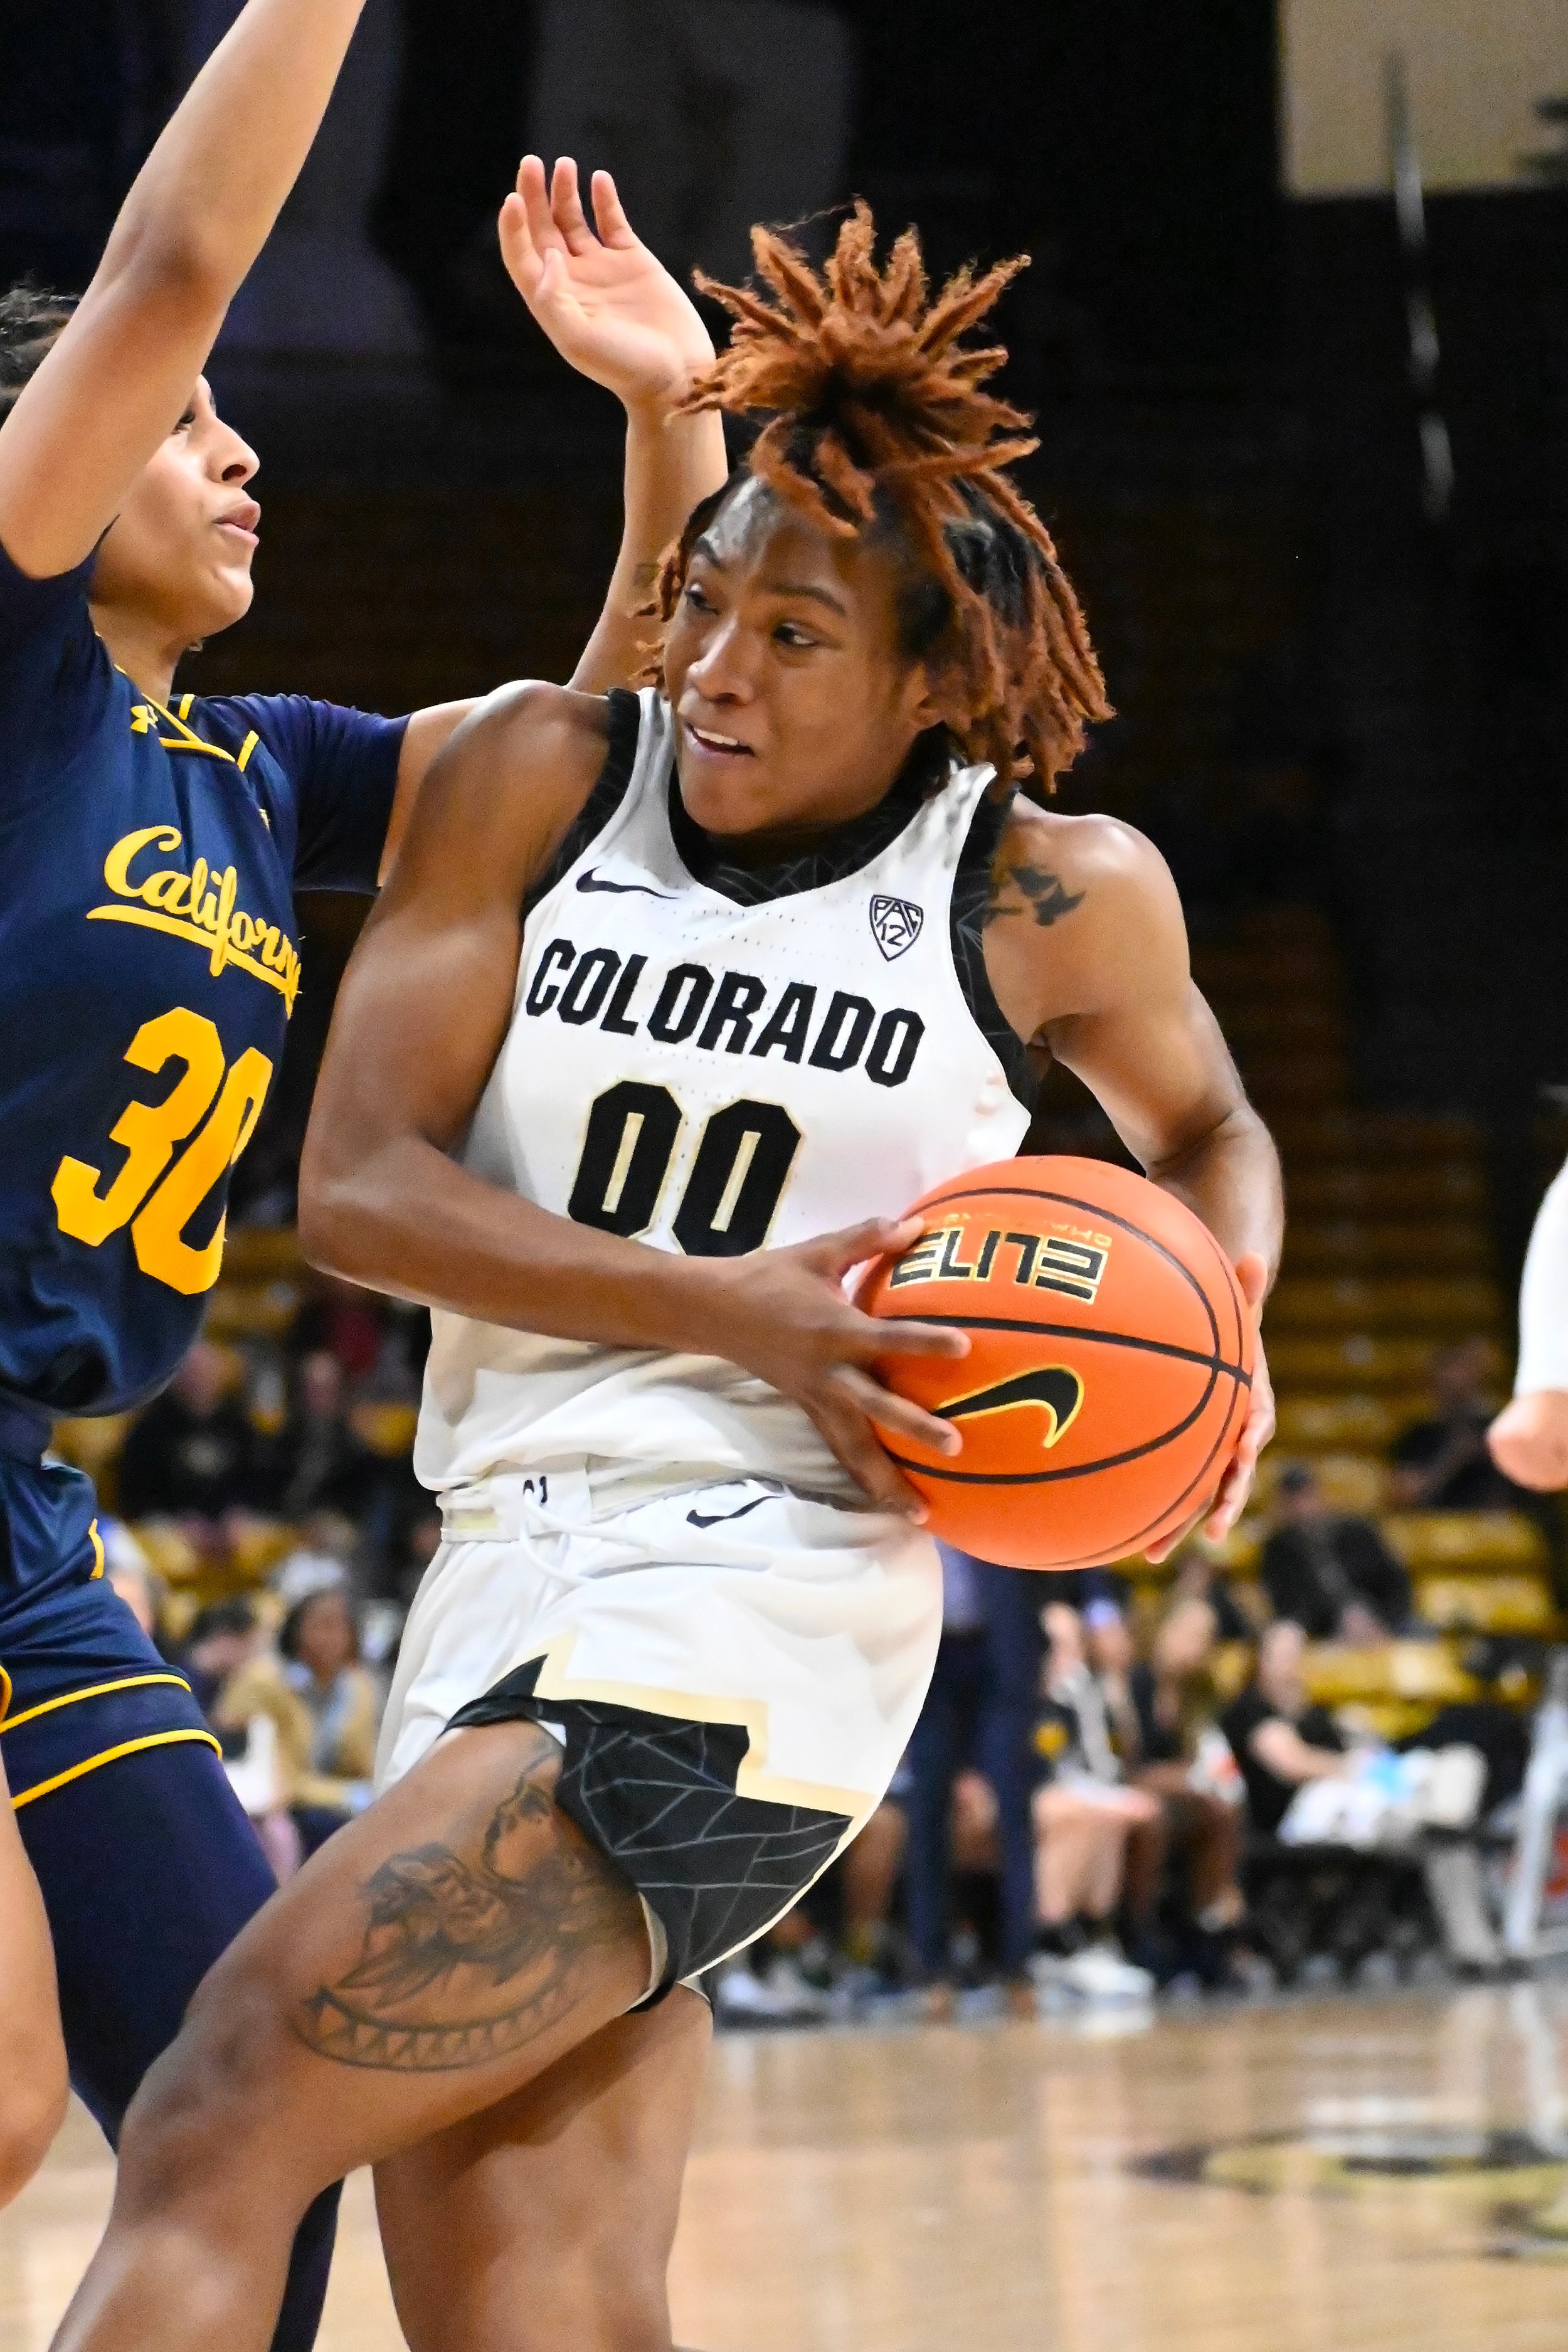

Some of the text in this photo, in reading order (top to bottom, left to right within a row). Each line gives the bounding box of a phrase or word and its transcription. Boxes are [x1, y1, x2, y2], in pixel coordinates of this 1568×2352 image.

[874, 898, 921, 937] PAC
[881, 923, 906, 946] 12
[526, 938, 926, 1088] COLORADO
[51, 1007, 273, 1295] 30
[567, 1079, 803, 1258] 00
[889, 1226, 1109, 1304] ELITE
